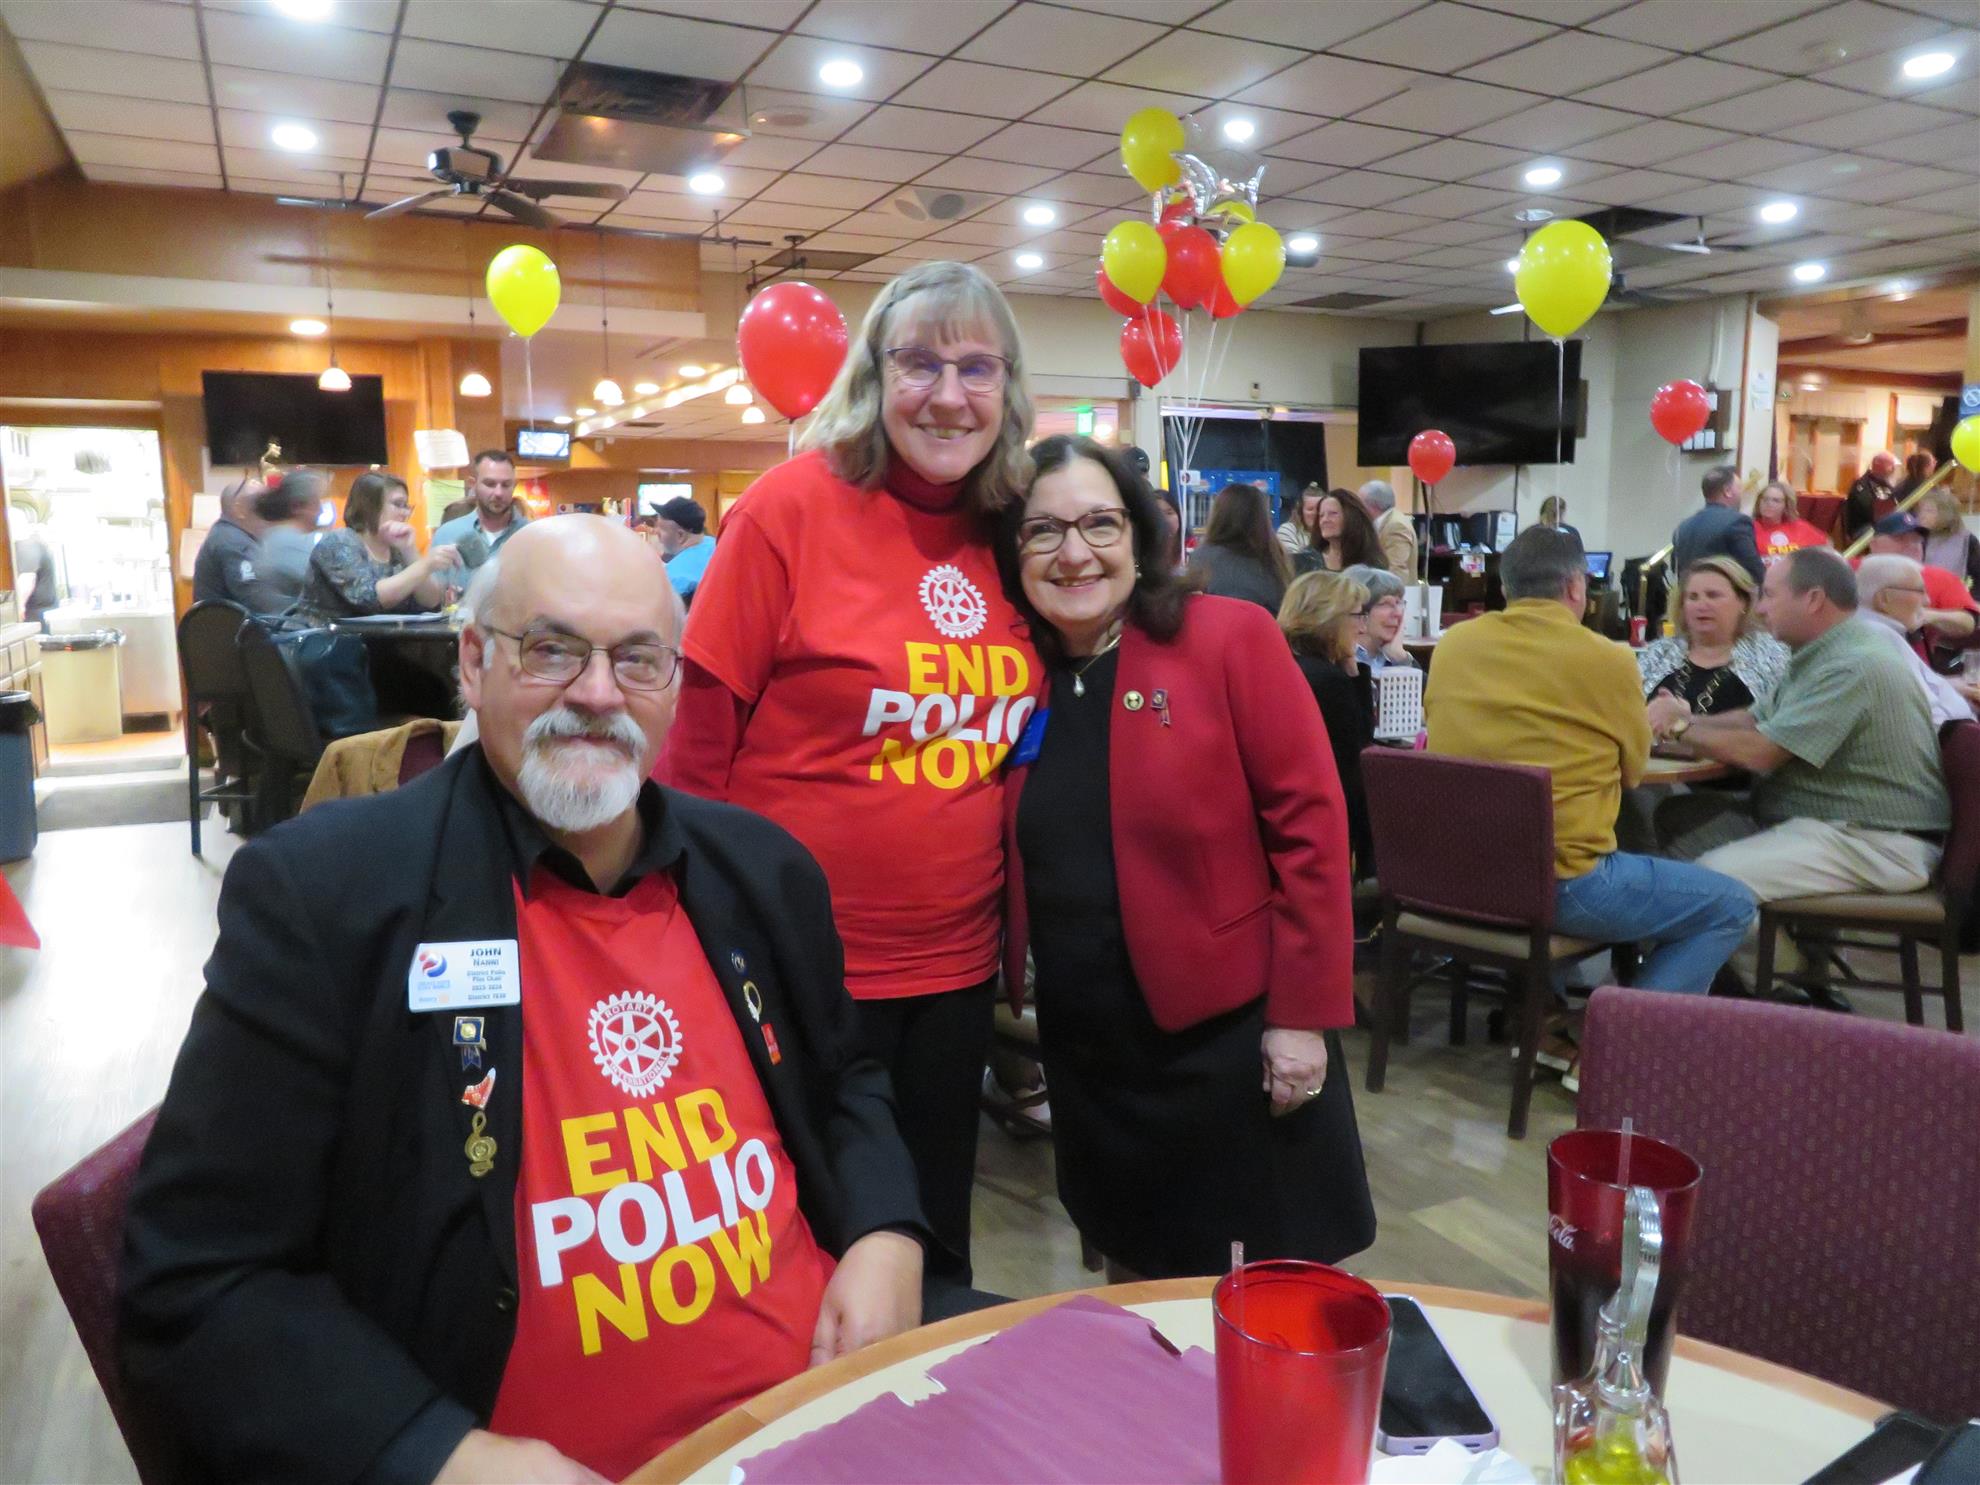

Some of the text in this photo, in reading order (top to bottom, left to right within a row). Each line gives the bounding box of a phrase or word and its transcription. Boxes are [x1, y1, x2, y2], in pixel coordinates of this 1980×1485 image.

[905, 641, 1029, 697] END
[470, 947, 502, 957] JOHN
[603, 1002, 651, 1019] ROTARY
[608, 1055, 670, 1087] INTERNATIONAL
[561, 1088, 738, 1196] END
[531, 1138, 775, 1288] POLIO
[571, 1209, 773, 1357] NOW
